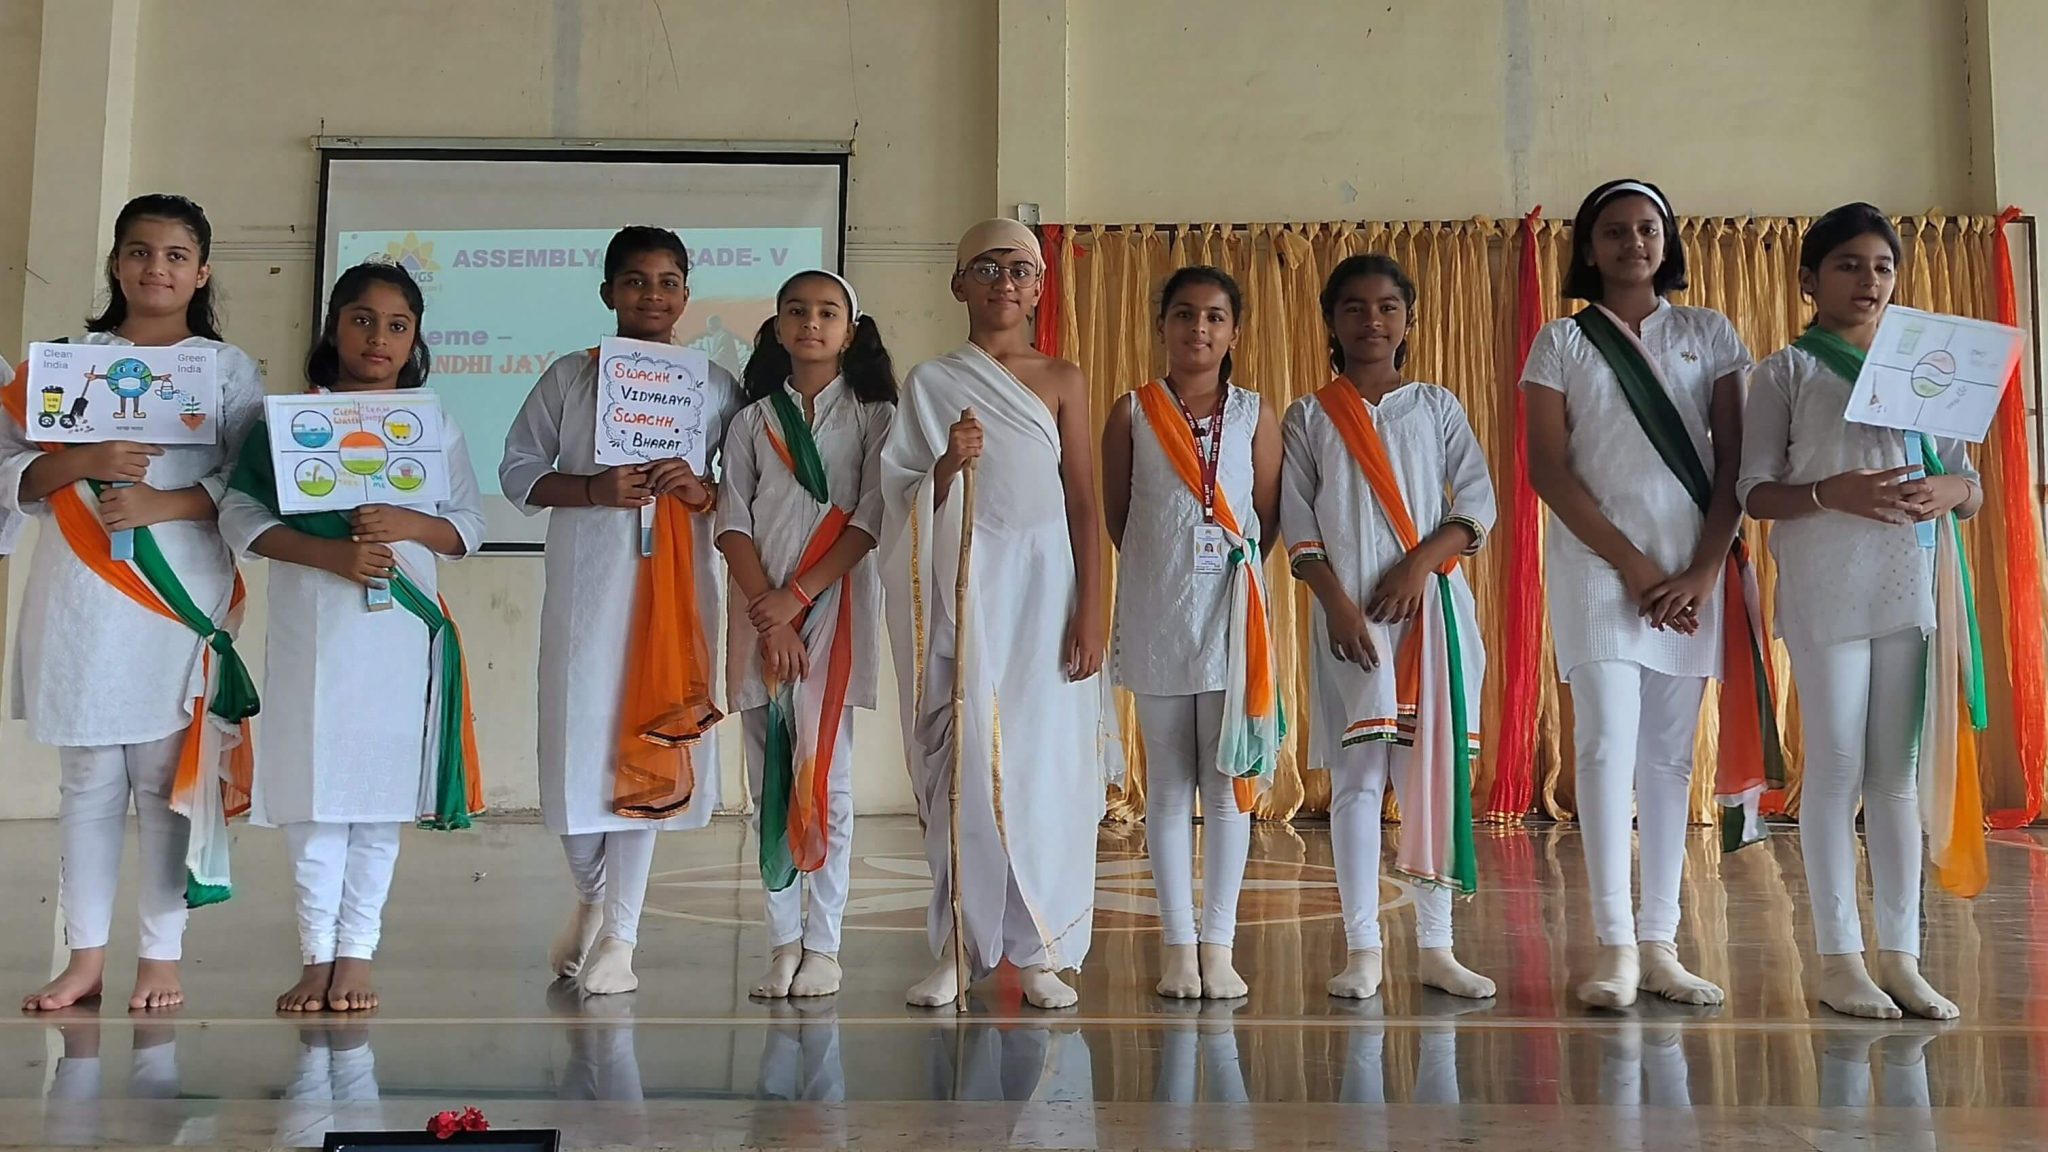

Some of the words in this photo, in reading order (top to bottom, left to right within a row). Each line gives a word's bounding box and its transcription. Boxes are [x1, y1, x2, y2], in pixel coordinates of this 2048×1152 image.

[453, 248, 600, 267] ASSEMBLY
[769, 247, 789, 267] V
[43, 349, 73, 359] Clean
[177, 353, 207, 363] Green
[43, 360, 69, 369] India
[177, 364, 202, 374] India
[614, 362, 671, 383] SWACHH
[621, 385, 692, 407] VIDYALAYA
[613, 407, 674, 428] SWACHH
[632, 432, 682, 451] BHARAT
